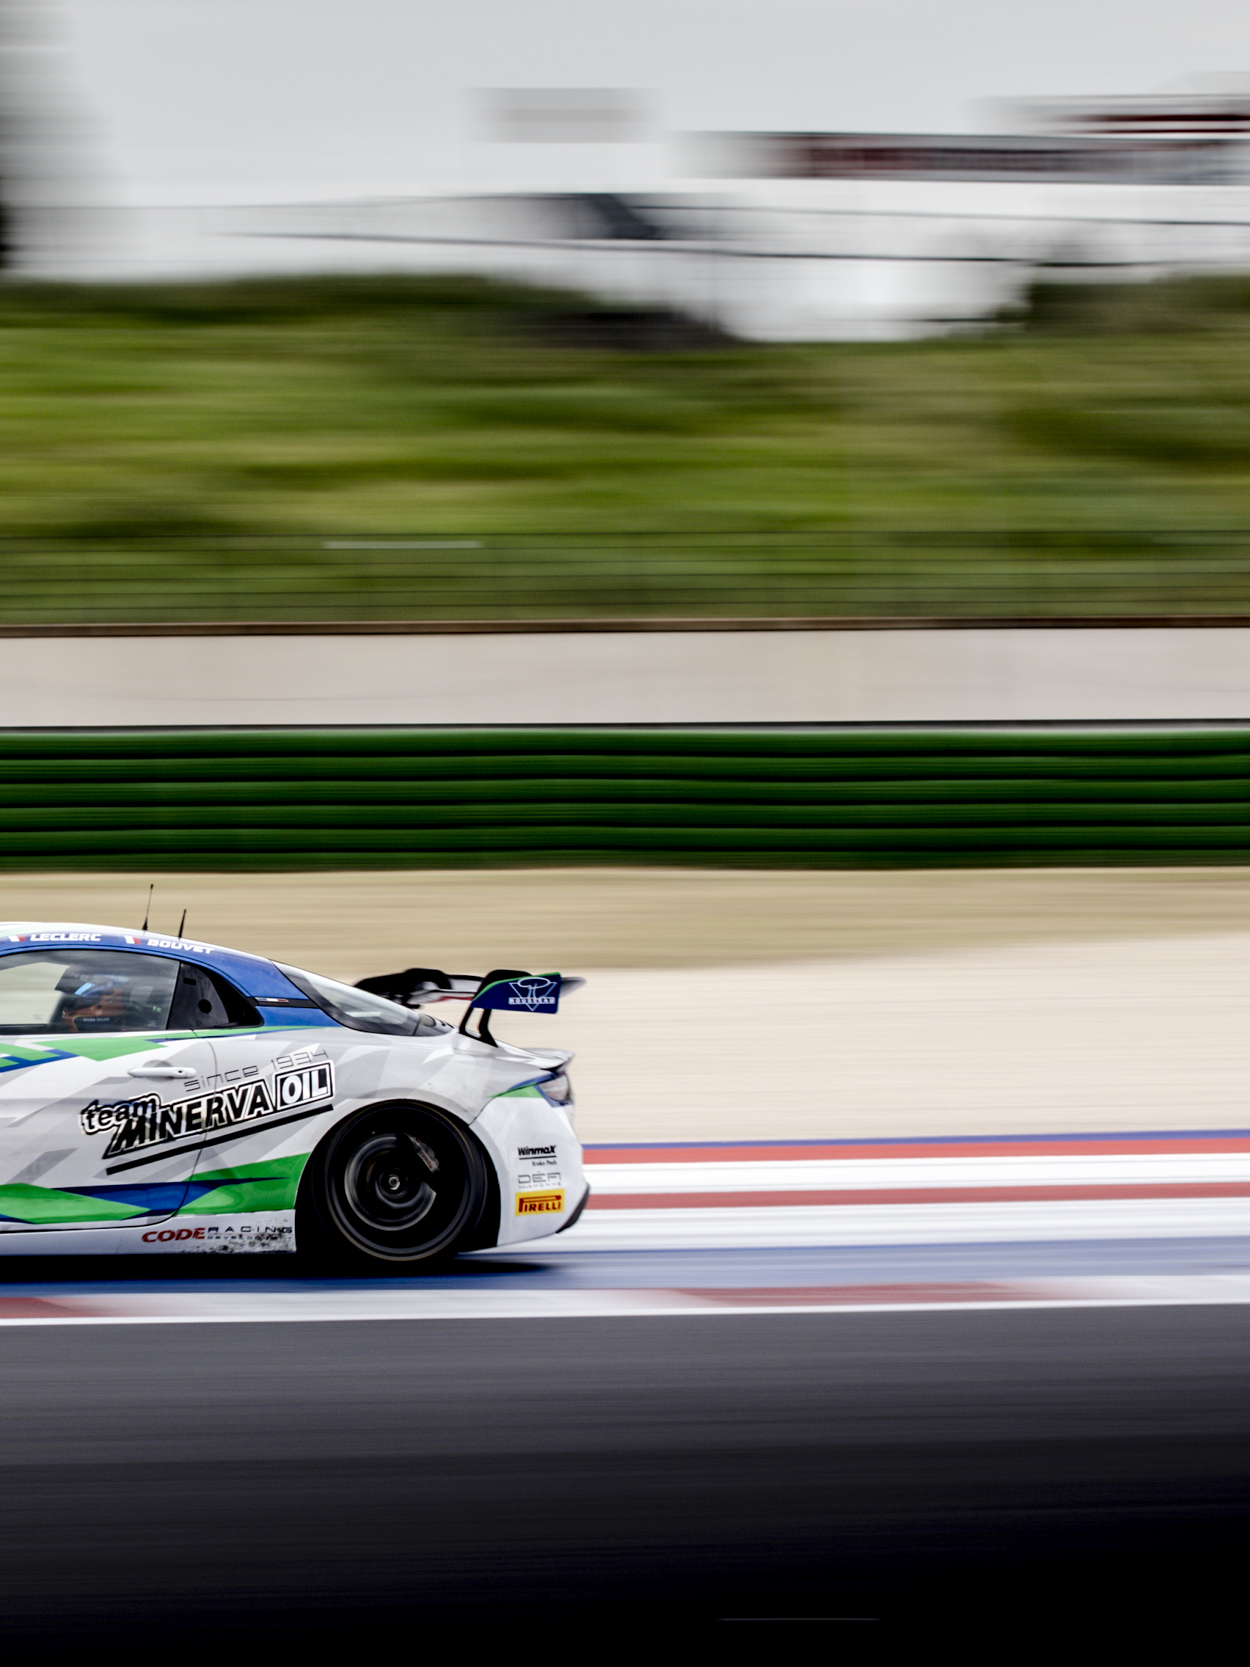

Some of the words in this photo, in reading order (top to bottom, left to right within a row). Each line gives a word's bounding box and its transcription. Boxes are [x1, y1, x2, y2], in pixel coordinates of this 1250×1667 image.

[30, 933, 102, 942] LECLERC
[147, 938, 216, 955] BOUVET
[281, 1069, 328, 1105] OIL
[80, 1092, 162, 1136] team
[102, 1081, 273, 1160] MINERVA
[518, 1194, 562, 1213] PIRELLI
[141, 1227, 206, 1243] CODE
